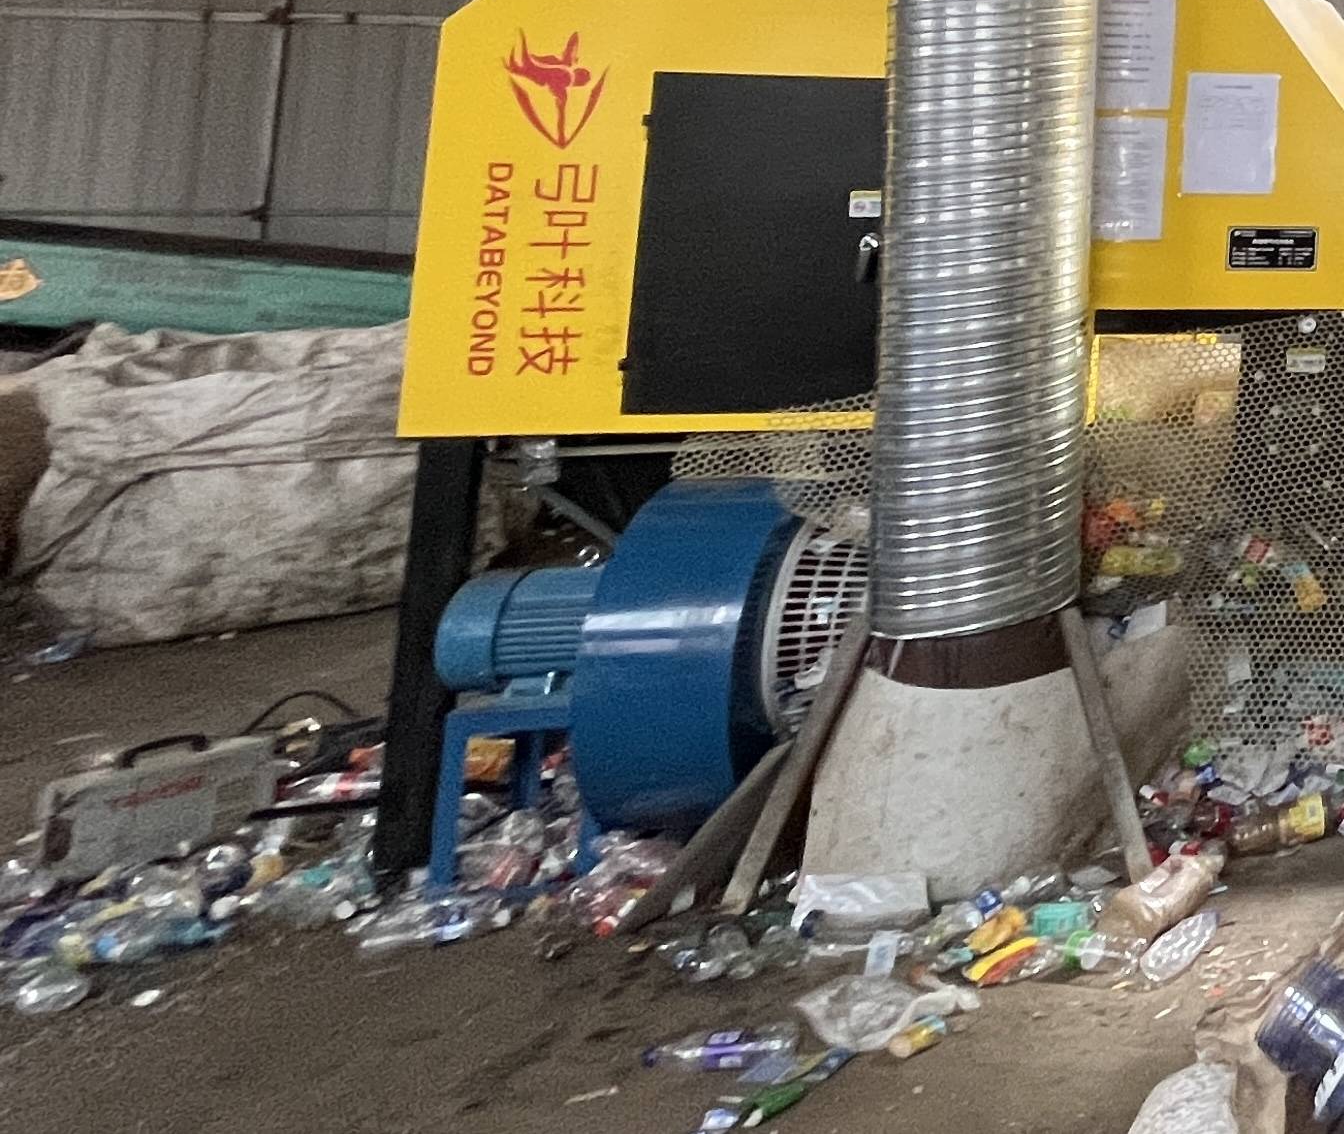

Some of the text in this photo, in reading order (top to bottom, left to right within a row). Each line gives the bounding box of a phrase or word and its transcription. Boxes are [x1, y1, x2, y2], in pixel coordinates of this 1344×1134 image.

[468, 163, 513, 376] DATABEYOND
[517, 164, 598, 376] 弓叶科技
